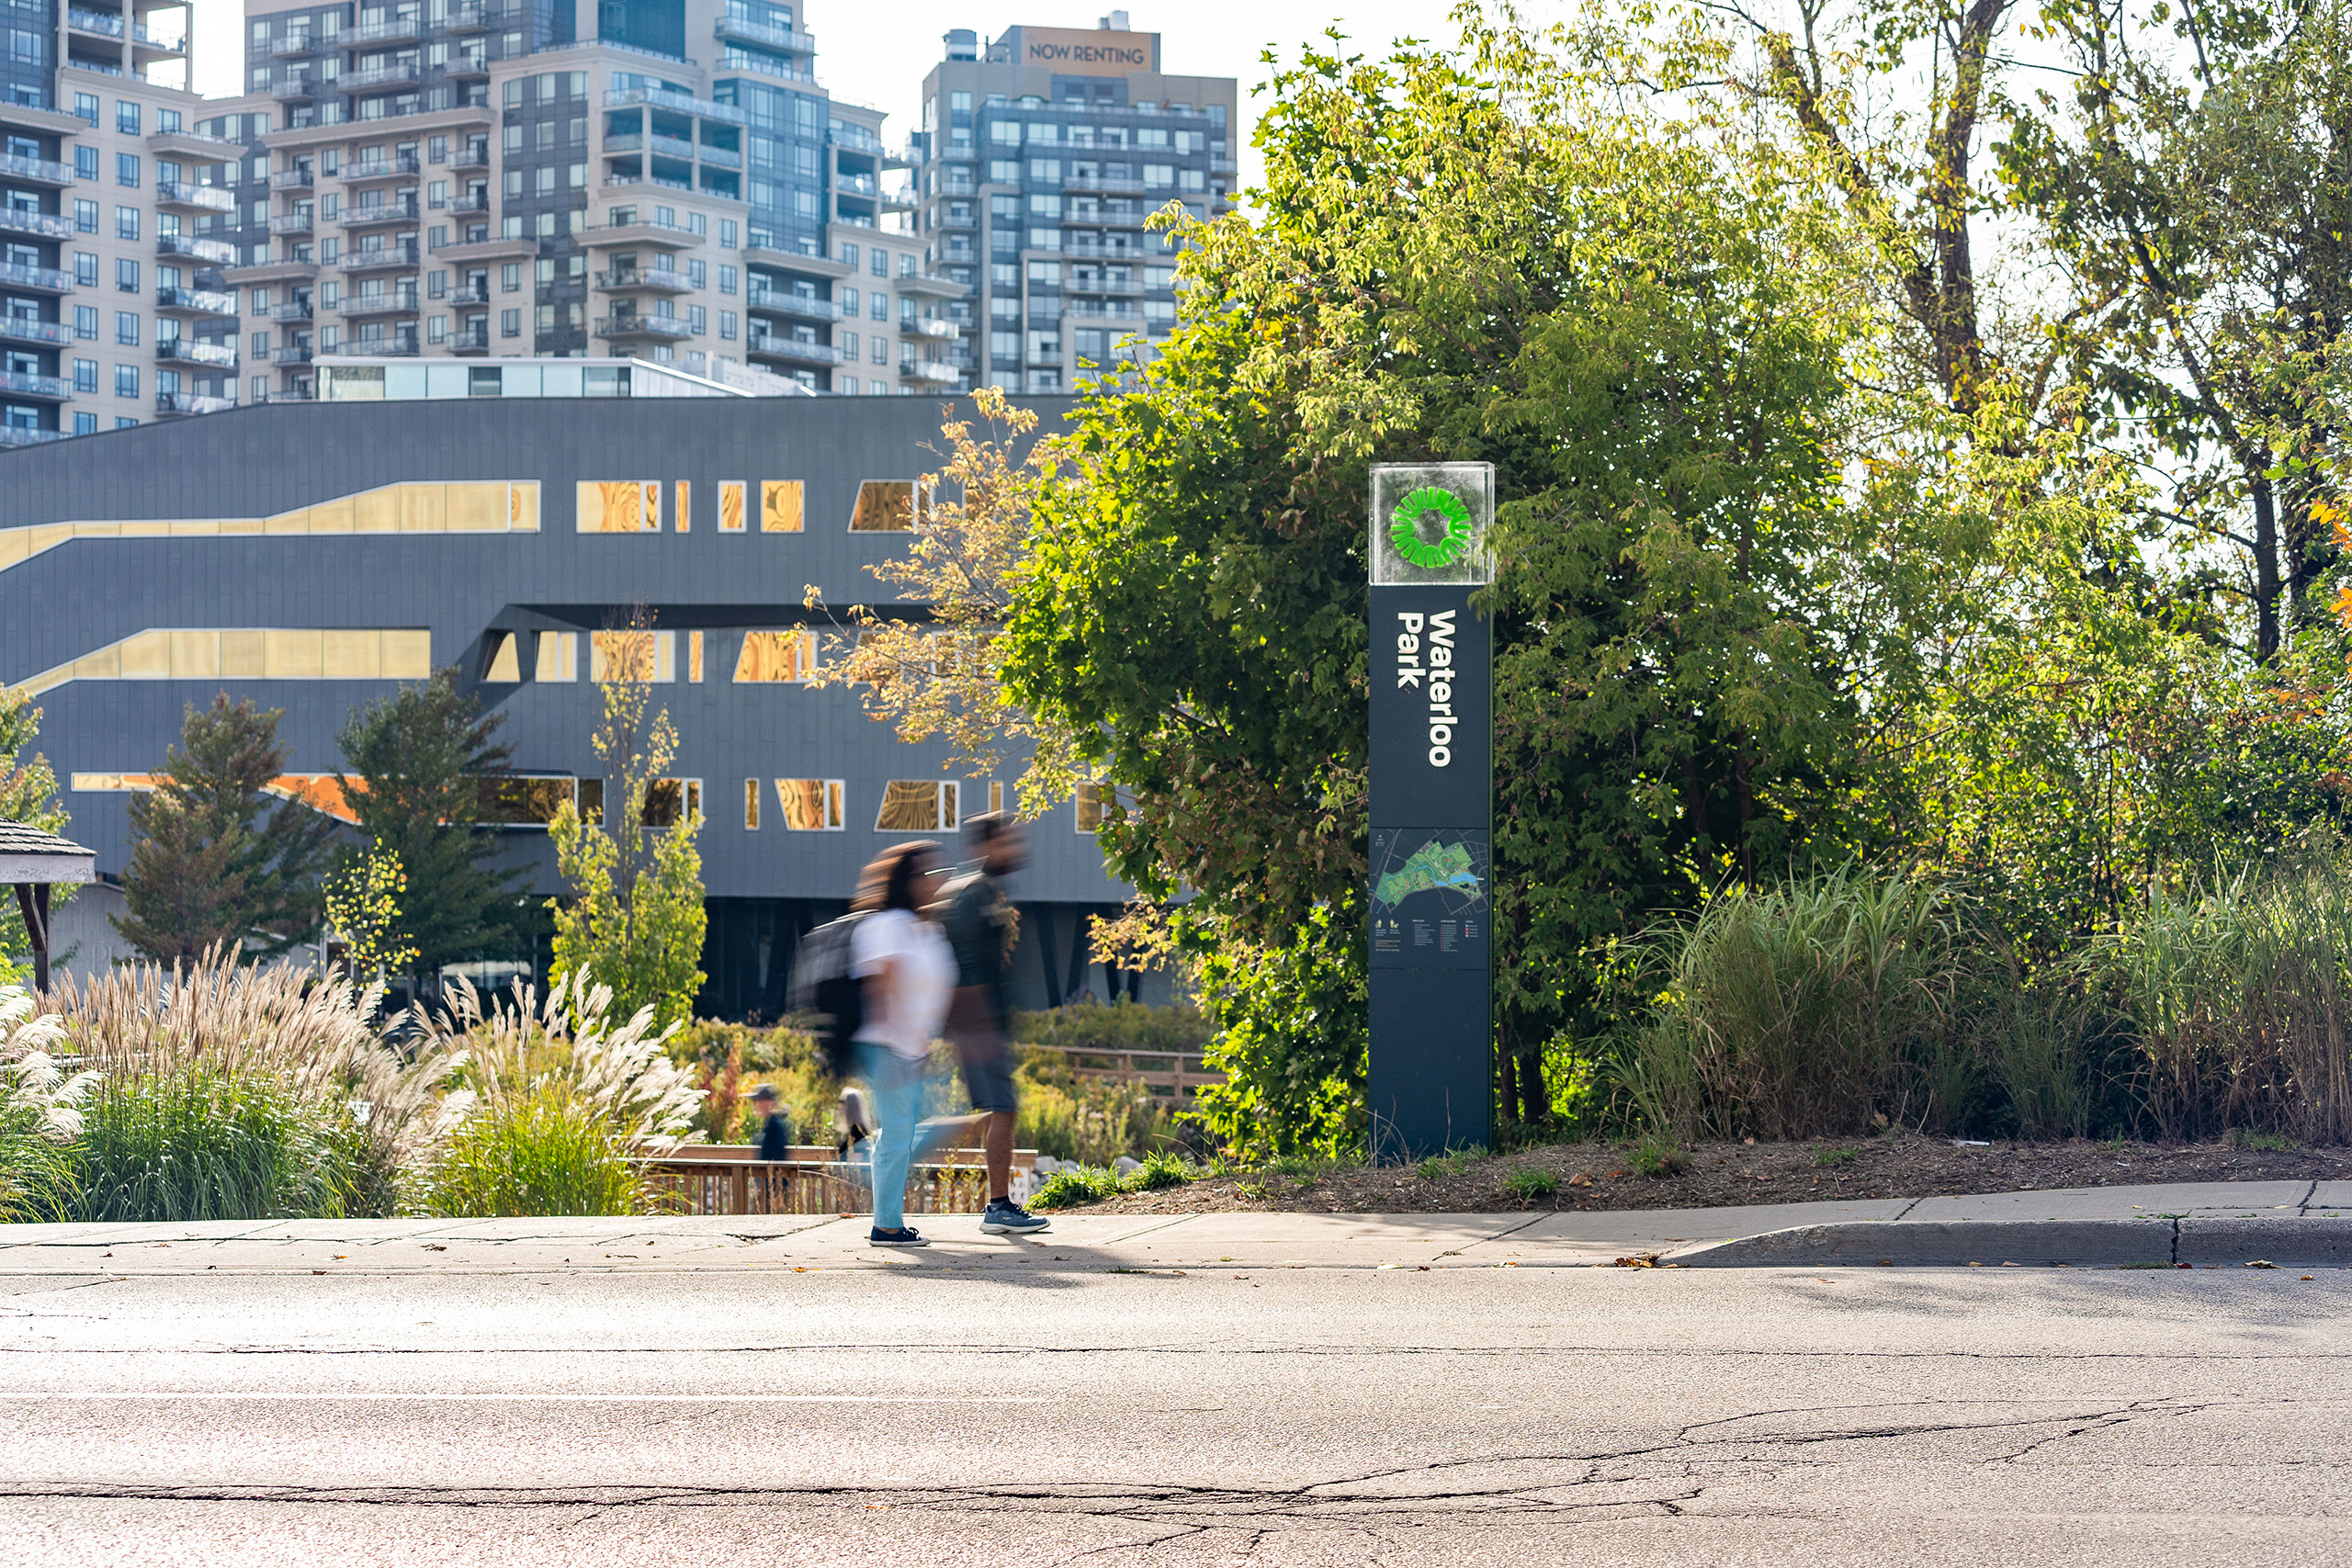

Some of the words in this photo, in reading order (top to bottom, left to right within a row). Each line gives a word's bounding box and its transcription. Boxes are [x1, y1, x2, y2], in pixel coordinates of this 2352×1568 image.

[1029, 44, 1071, 60] NOW
[1074, 46, 1144, 64] RENTING
[1396, 612, 1426, 689] Park
[1429, 609, 1458, 768] Waterloo
